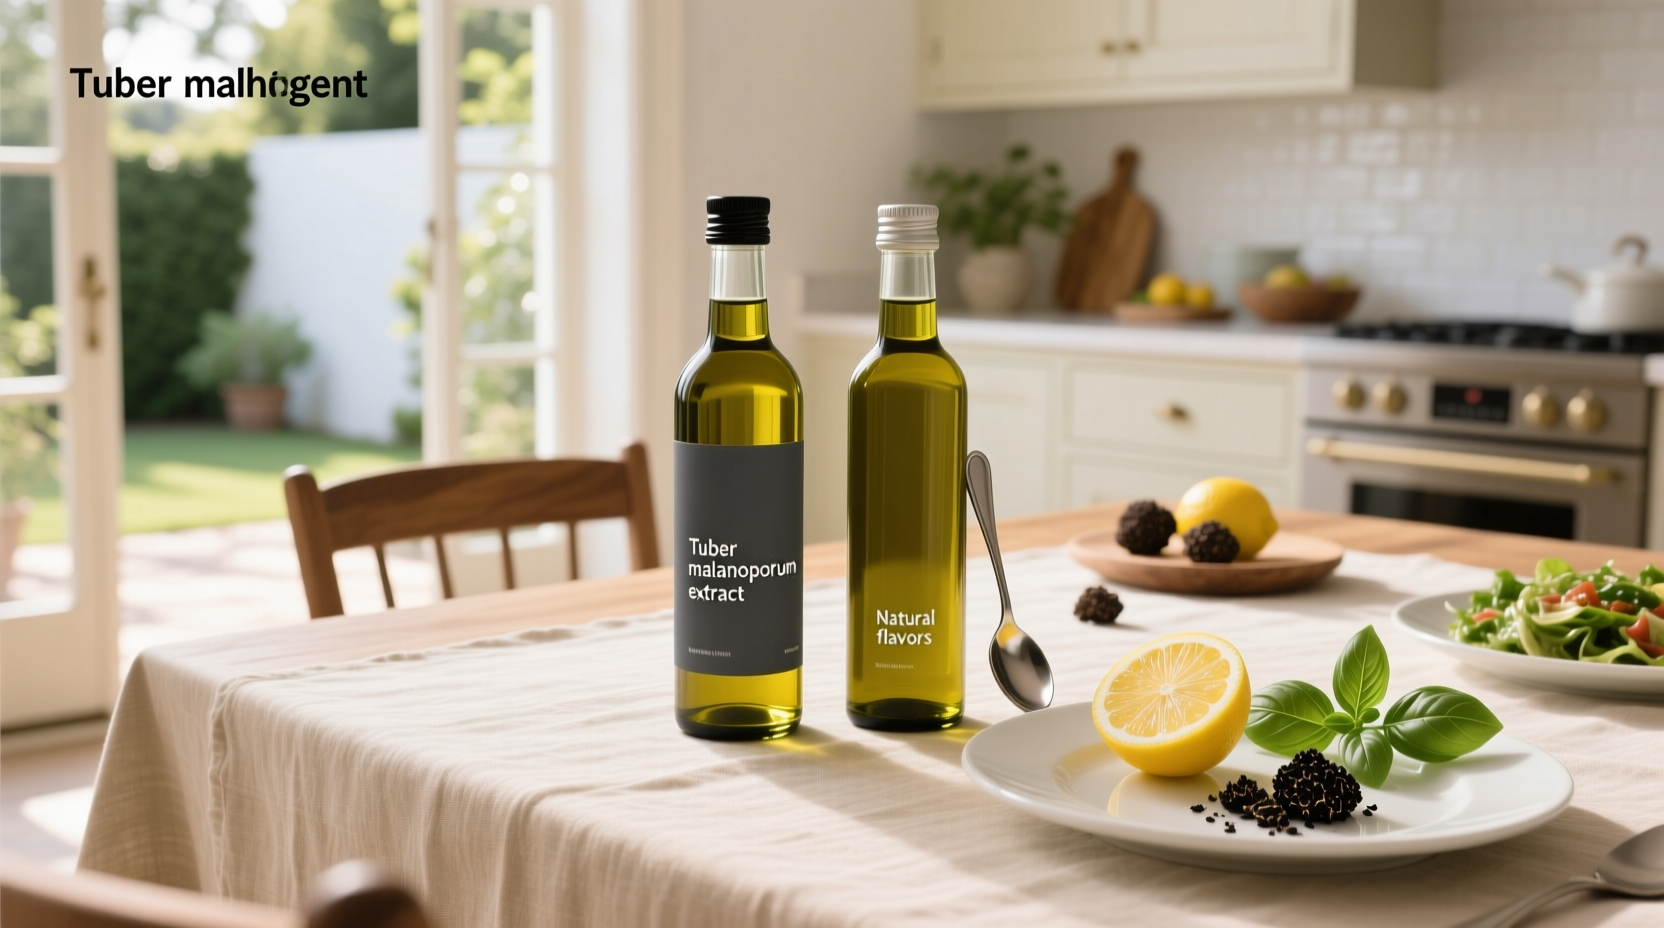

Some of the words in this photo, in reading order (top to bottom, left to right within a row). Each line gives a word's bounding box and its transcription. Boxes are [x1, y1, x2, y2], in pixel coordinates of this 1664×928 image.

[688, 537, 738, 557] Tuber
[688, 560, 797, 583] malanoporum
[688, 584, 745, 602] extract
[876, 608, 935, 626] Natural
[876, 628, 933, 646] flavors
